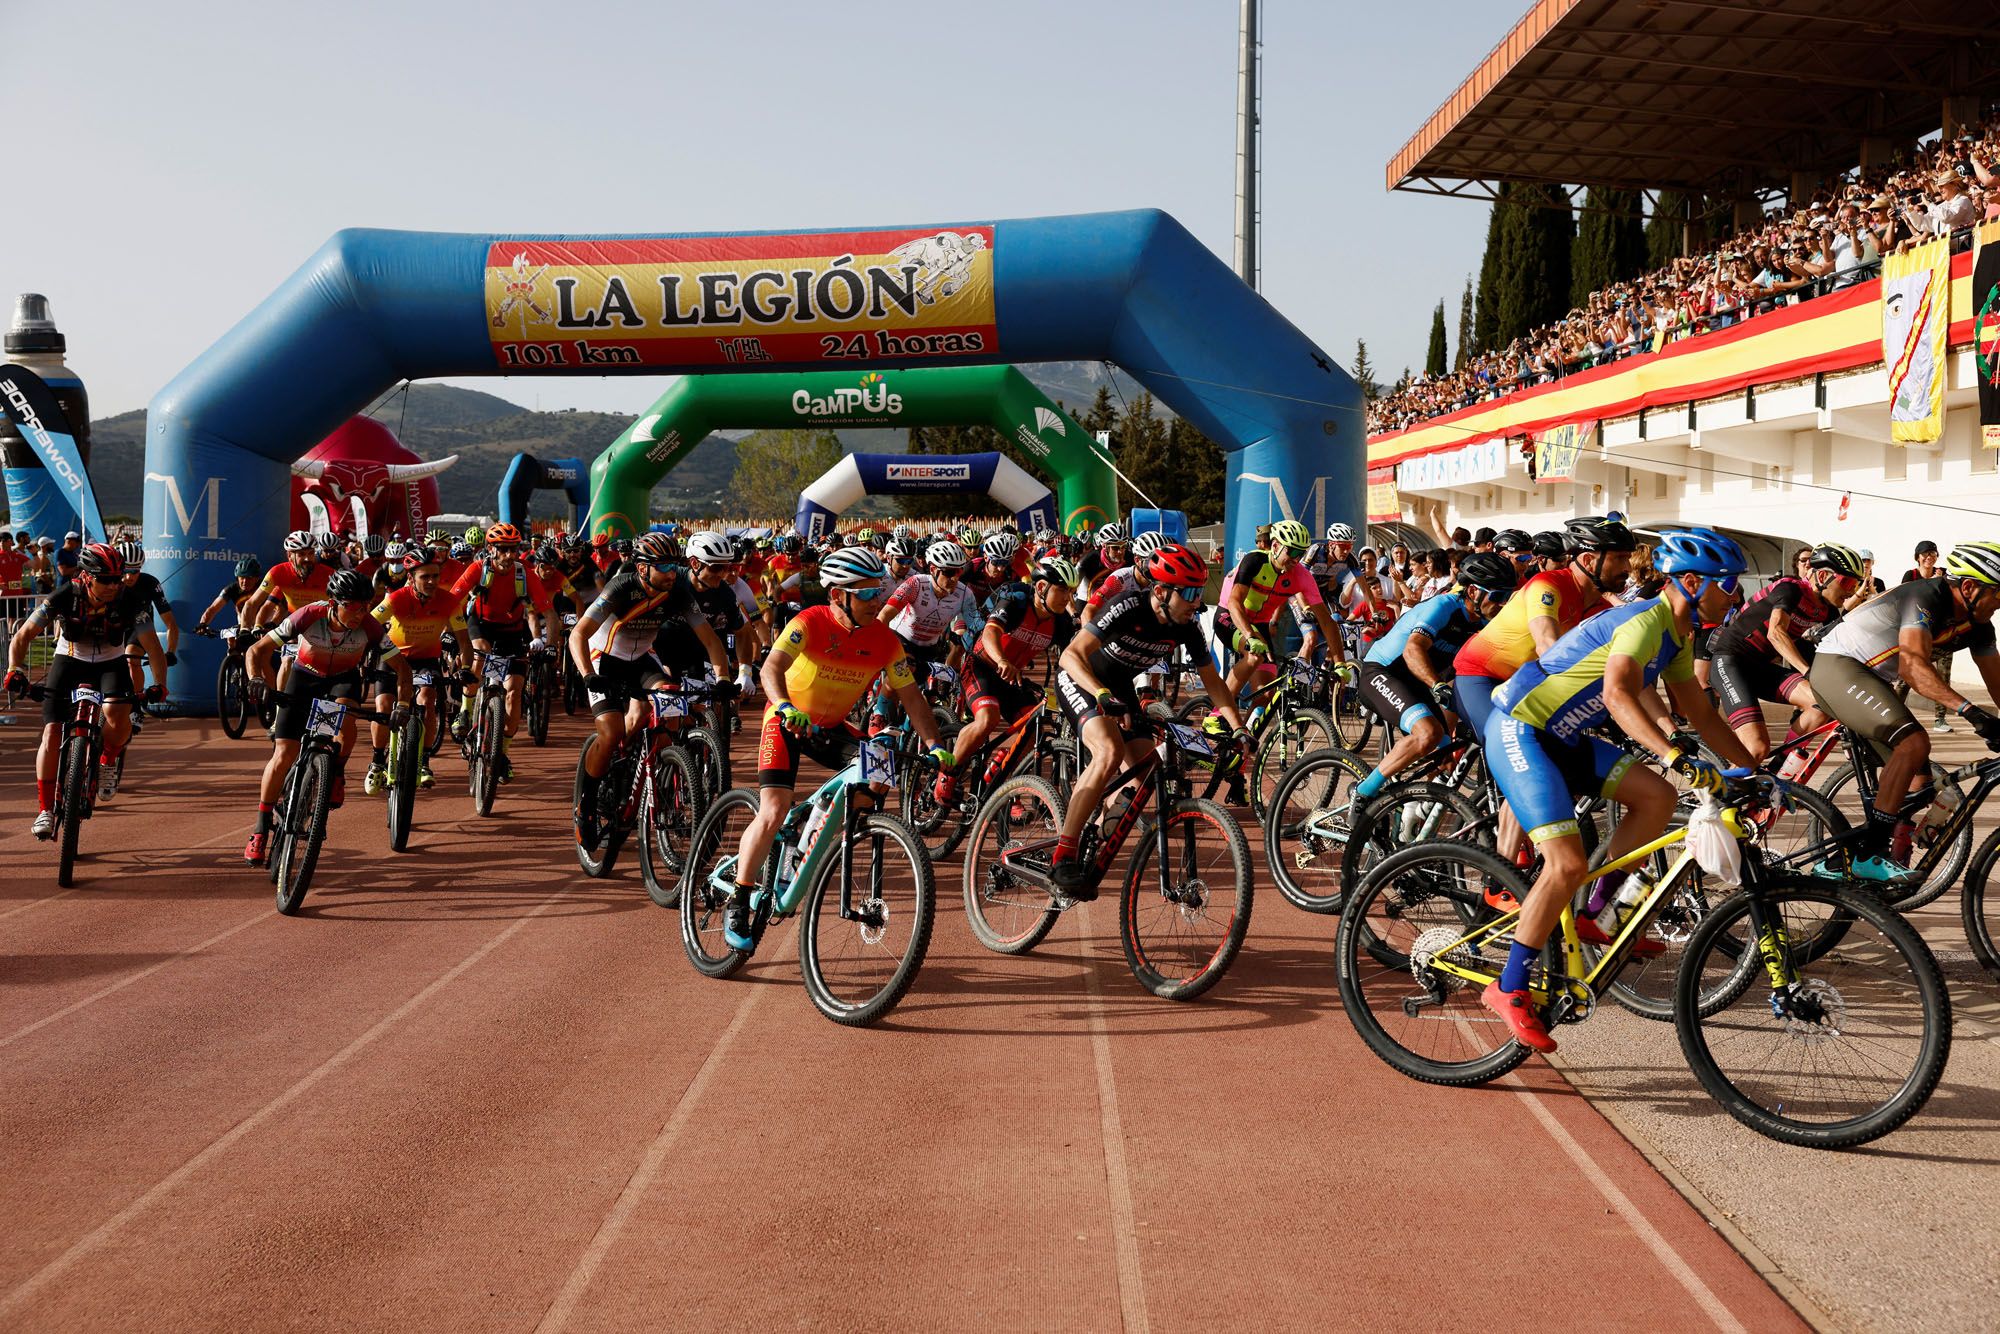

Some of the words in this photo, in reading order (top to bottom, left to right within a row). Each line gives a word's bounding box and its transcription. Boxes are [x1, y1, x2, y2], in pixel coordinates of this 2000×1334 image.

[555, 278, 644, 329] LA
[659, 254, 921, 328] LEGIÓN
[502, 342, 574, 366] 101
[577, 341, 642, 365] km
[820, 332, 875, 358] 24
[878, 329, 985, 355] horas
[645, 430, 678, 460] Fundación
[657, 440, 681, 462] Unicaja
[1018, 423, 1051, 454] Fundación
[1018, 434, 1041, 457] Unicaja
[901, 467, 967, 478] INTERSPORT
[144, 472, 227, 540] M
[407, 481, 425, 542] HYSIOREL
[184, 547, 200, 560] de
[1097, 596, 1140, 631] SUPÉRATE
[1108, 641, 1163, 669] SUPÉRAT
[1372, 676, 1406, 712] MOBALPA
[765, 722, 780, 733] La
[1551, 690, 1605, 739] GENALBI
[760, 734, 778, 766] Legión
[1501, 719, 1530, 773] GENALBIKE
[1621, 753, 1635, 765] SO
[1733, 1101, 1831, 1137] SCHWALBE
